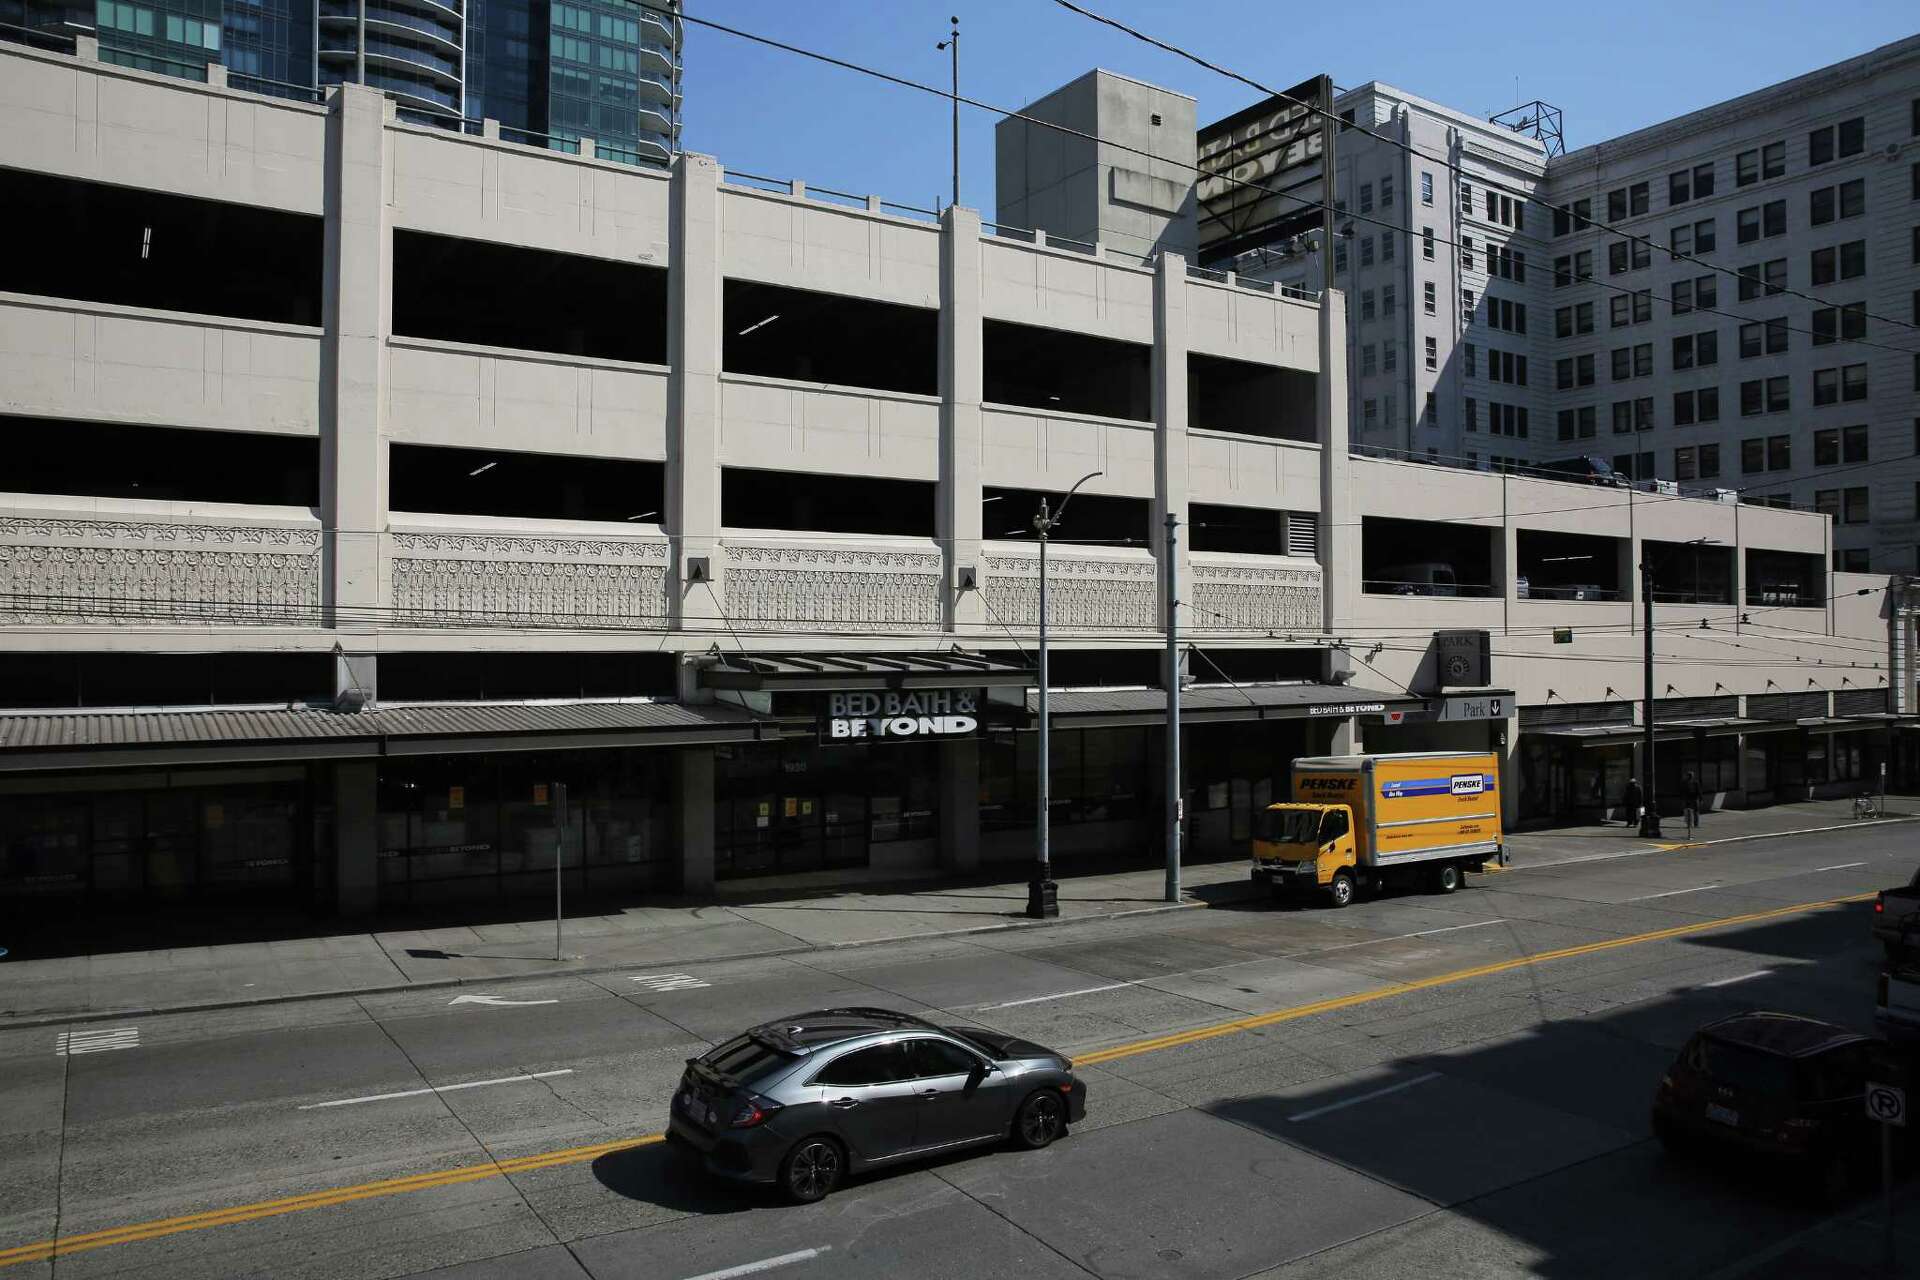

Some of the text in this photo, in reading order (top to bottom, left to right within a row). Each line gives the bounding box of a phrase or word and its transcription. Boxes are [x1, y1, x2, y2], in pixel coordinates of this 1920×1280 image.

[832, 690, 978, 716] BED BATH &
[1310, 706, 1322, 714] BED
[1323, 705, 1338, 714] BATH
[1345, 704, 1385, 713] BEYOND
[1464, 702, 1485, 717] Park
[831, 716, 978, 738] BEYOND
[1302, 779, 1357, 790] PENSKE
[1453, 780, 1481, 789] PENSKE
